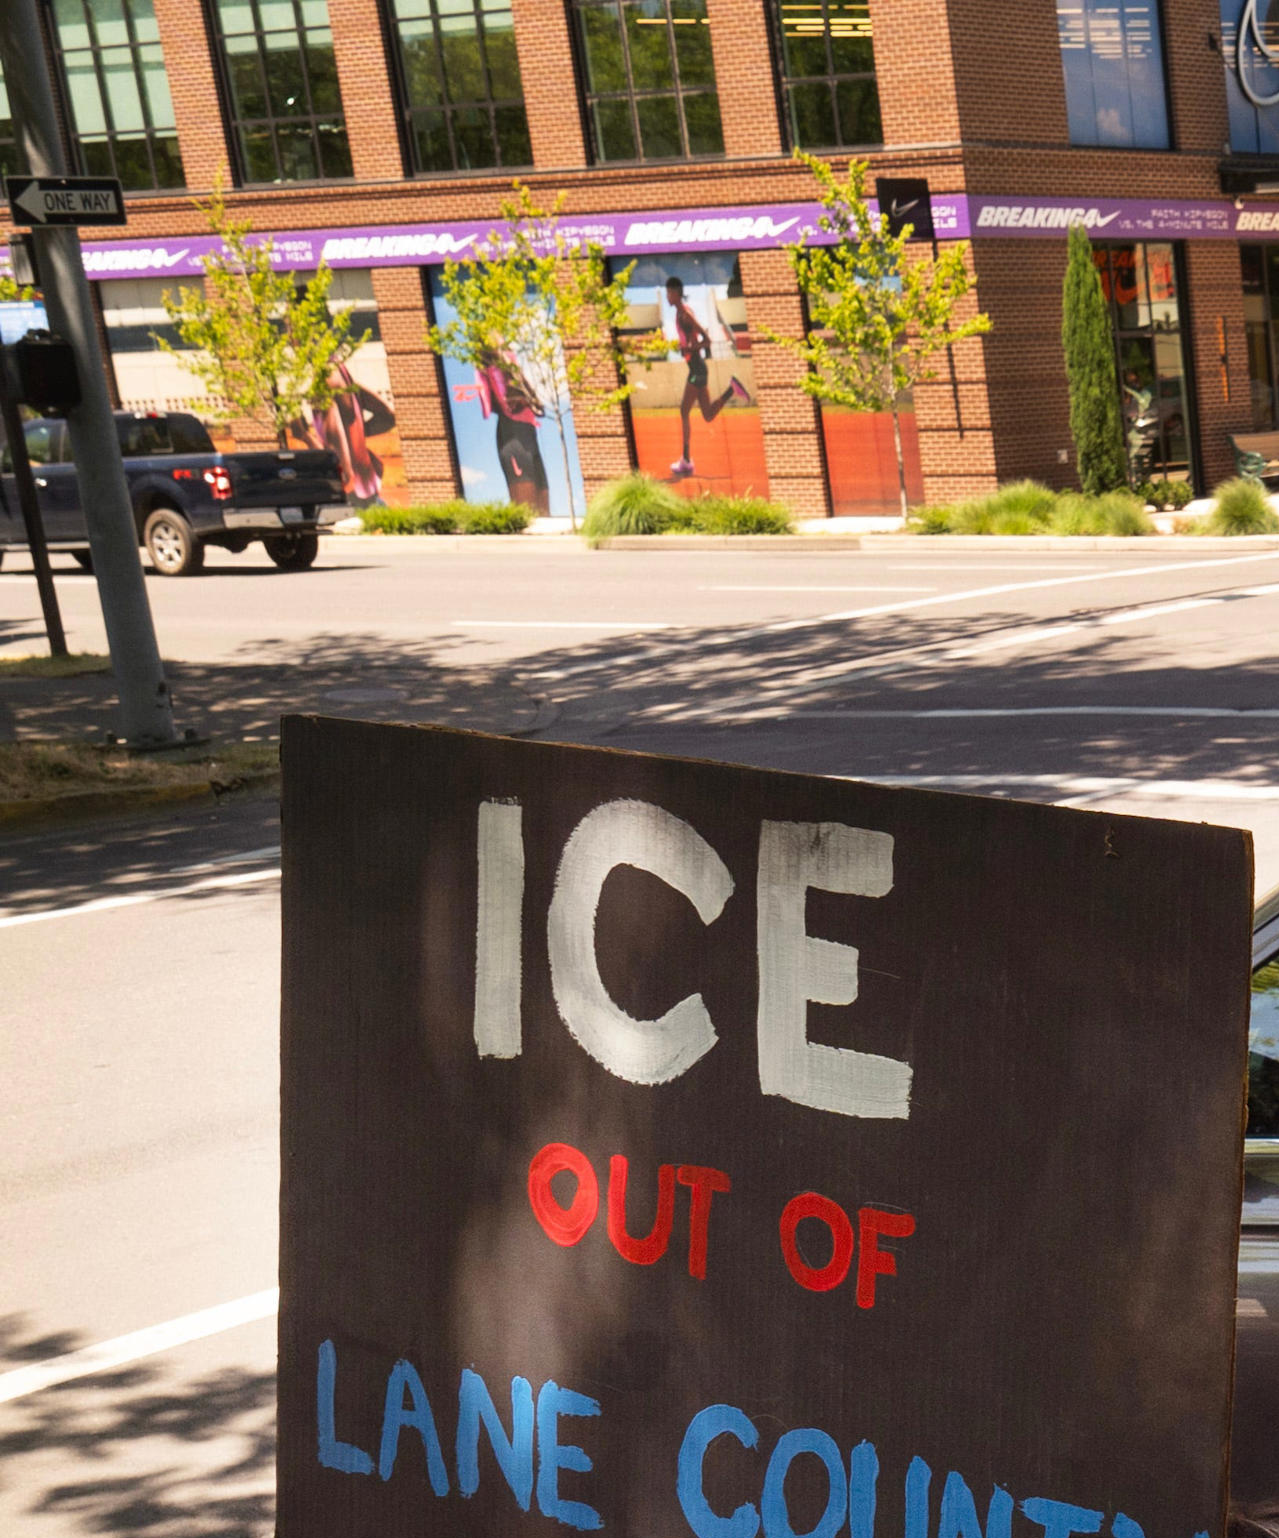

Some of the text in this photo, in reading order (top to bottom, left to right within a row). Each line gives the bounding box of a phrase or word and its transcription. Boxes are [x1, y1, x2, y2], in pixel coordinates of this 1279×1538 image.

[44, 192, 111, 211] ONE WAY
[624, 216, 773, 246] BREAKING4
[977, 206, 1100, 228] BREAKING4
[474, 797, 914, 1121] ICE
[527, 1140, 917, 1310] OUT OF
[315, 1338, 605, 1532] LANE
